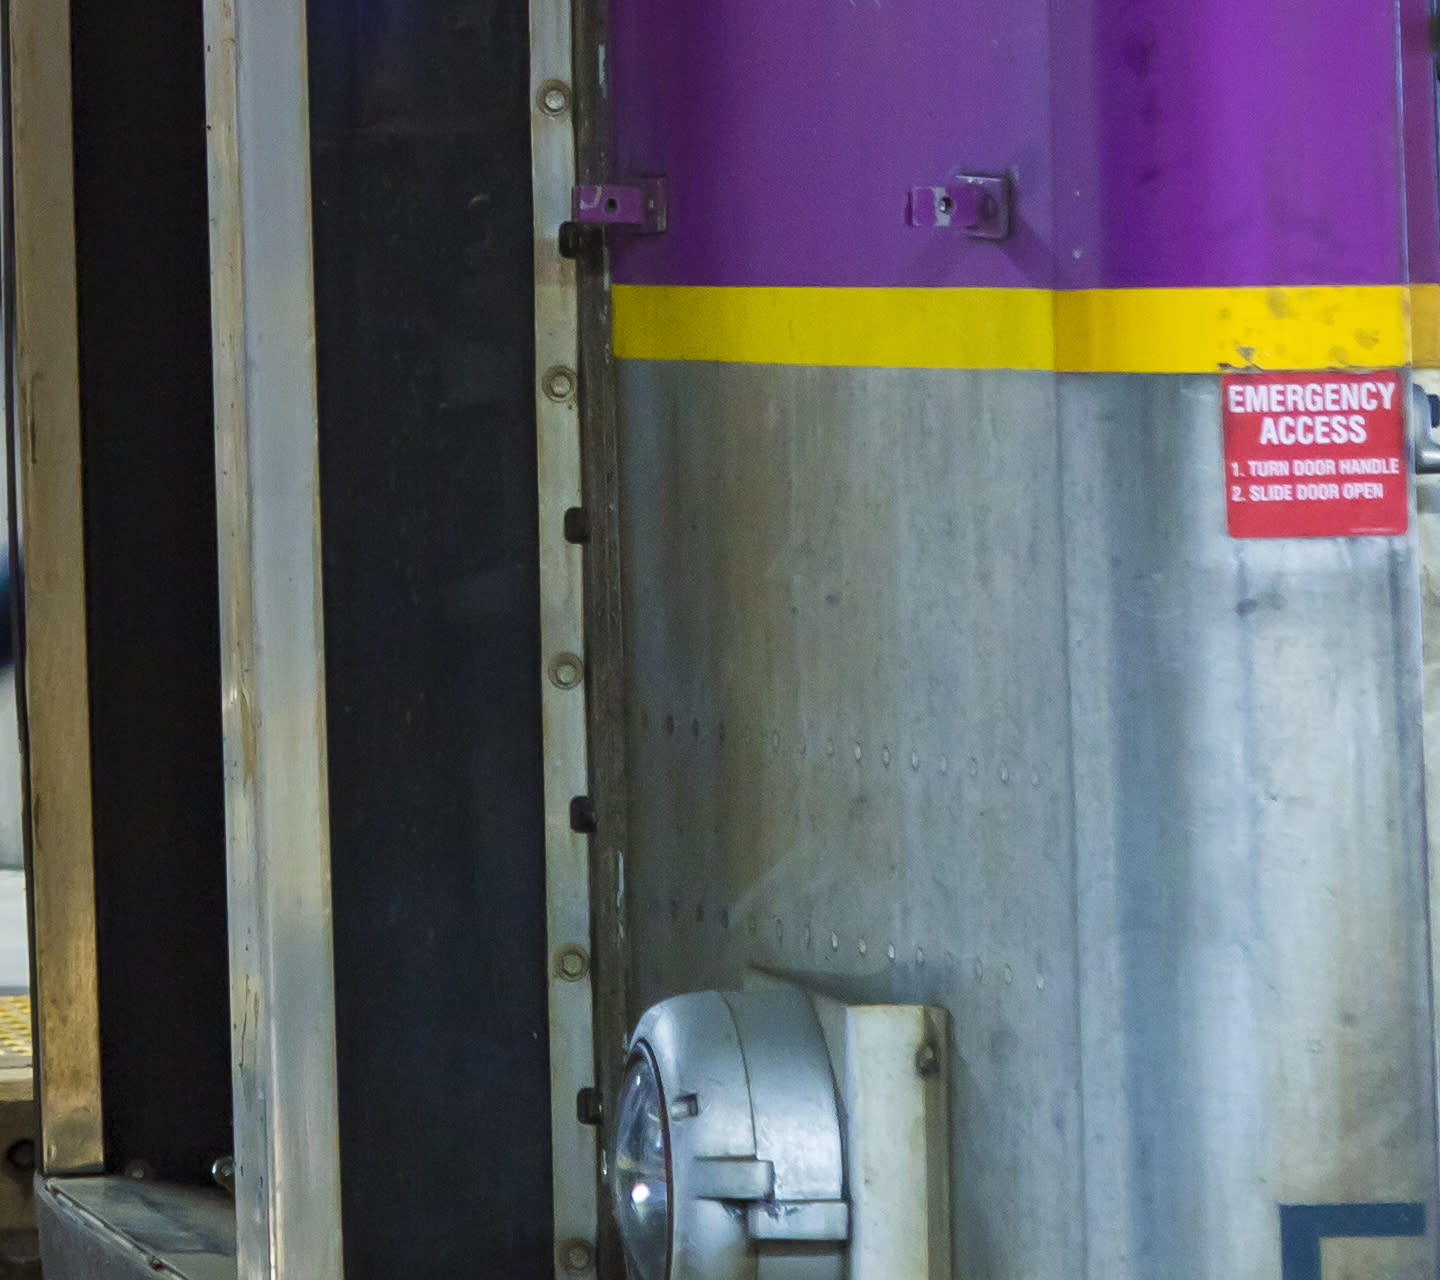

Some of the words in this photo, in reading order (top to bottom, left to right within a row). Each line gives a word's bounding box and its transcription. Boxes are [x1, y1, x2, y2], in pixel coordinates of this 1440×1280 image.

[1227, 382, 1395, 413] EMERGENCY
[1259, 414, 1367, 445] ACCESS
[1231, 462, 1246, 477] 1.
[1248, 460, 1289, 477] TURN
[1293, 459, 1336, 477] DOOR
[1339, 458, 1399, 475] HANDLE
[1232, 486, 1246, 502] 2.
[1249, 484, 1293, 501] SLIDE
[1296, 484, 1339, 501] DOOR
[1342, 482, 1384, 499] OPEN
